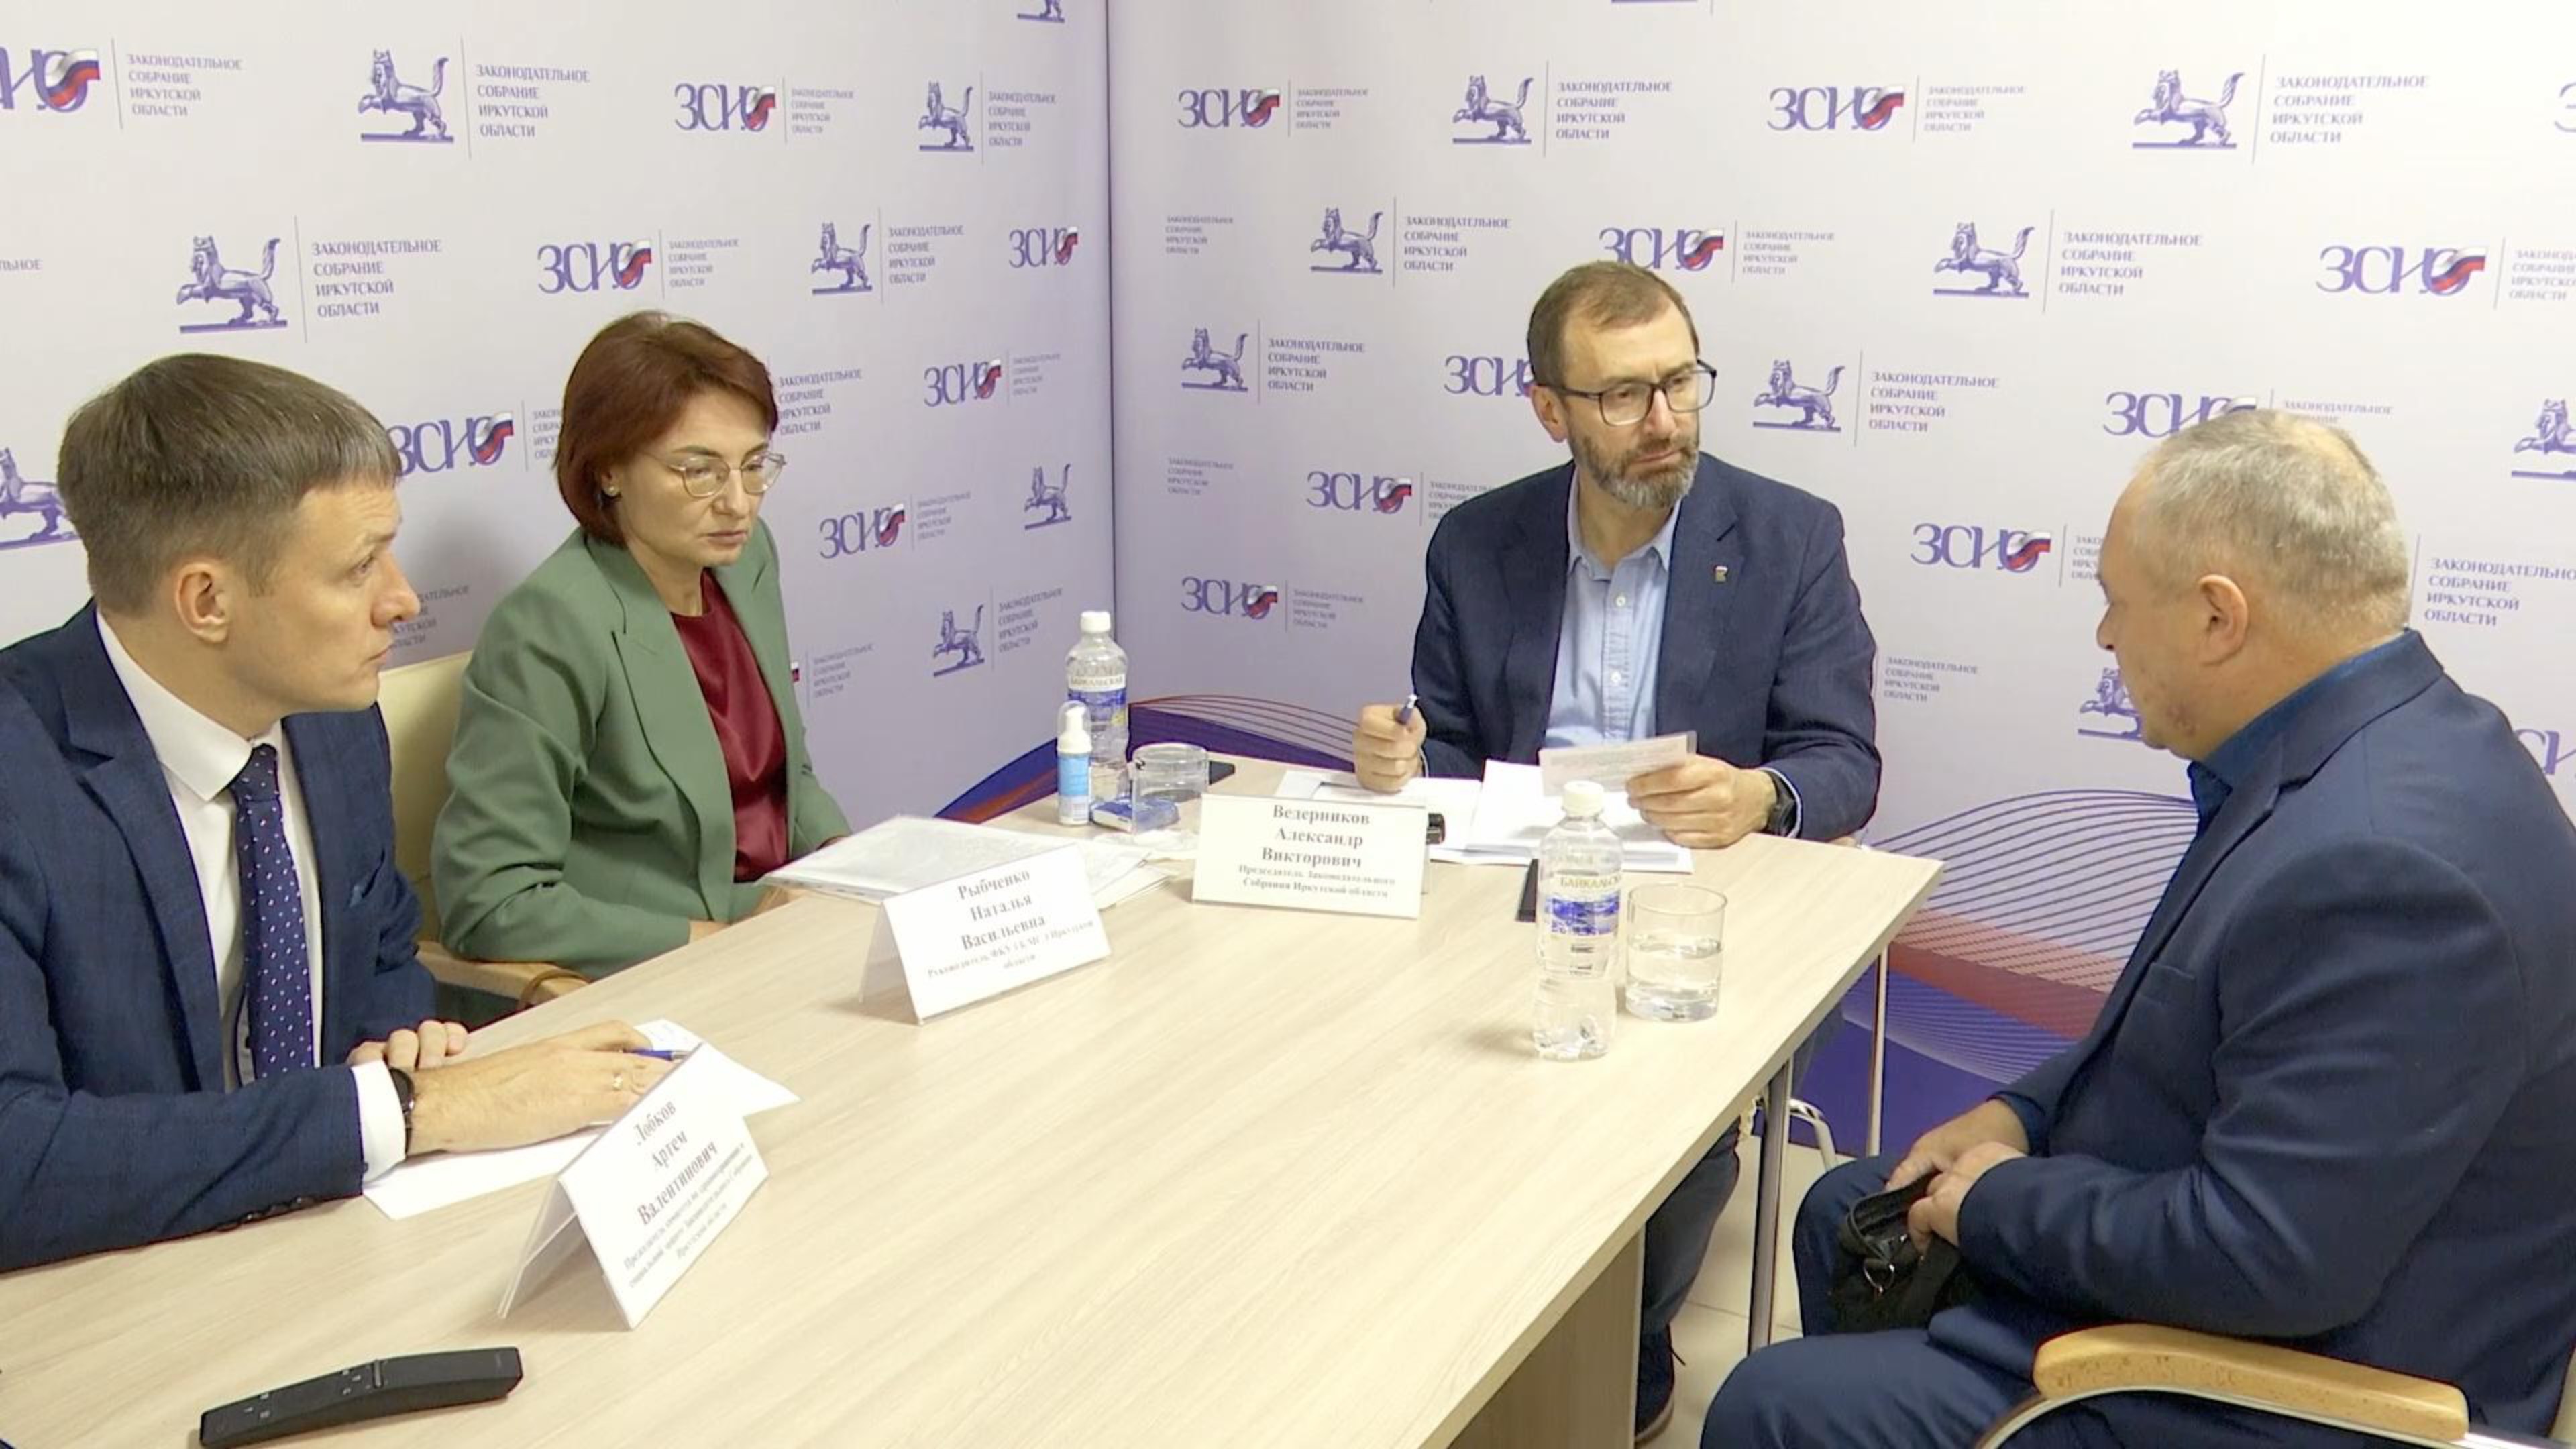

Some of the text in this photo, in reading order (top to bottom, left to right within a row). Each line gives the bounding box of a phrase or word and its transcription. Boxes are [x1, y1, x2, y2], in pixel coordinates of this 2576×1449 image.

[476, 64, 591, 83] ЗАКОНОДАТЕЛЬНОЕ
[1558, 80, 1672, 94] ЗАКОНОДАТЕЛЬНОЕ
[2277, 74, 2426, 90] ЗАКОНОДАТЕЛЬНОЕ
[476, 84, 539, 99] СОБРАНИЕ
[1556, 97, 1618, 109] СОБРАНИЕ
[2273, 95, 2351, 107] СОБРАНИЕ
[478, 103, 549, 119] ИРКУТСКОЙ
[1556, 112, 1626, 124] ИРКУТСКОЙ
[2272, 112, 2363, 125] ИРКУТСКОЙ
[479, 123, 535, 138] ОБЛАСТИ
[1555, 128, 1610, 140] ОБЛАСТИ
[2269, 131, 2341, 144] ОБЛАСТИ
[1407, 215, 1510, 229] ЗАКОНОДАТЕЛЬНОЕ
[1403, 231, 1458, 243] СОБРАНИЕ
[2064, 231, 2202, 246] ЗАКОНОДАТЕЛЬНОЕ
[311, 239, 442, 256] ЗАКОНОДАТЕЛЬНОЕ
[1403, 246, 1468, 258] ИРКУТСКОЙ
[2061, 249, 2133, 262] СОБРАНИЕ
[313, 260, 384, 277] СОБРАНИЕ
[1403, 260, 1454, 272] ОБЛАСТИ
[2060, 266, 2144, 280] ИРКУТСКОЙ
[315, 278, 394, 297] ИРКУТСКОЙ
[2058, 282, 2125, 296] ОБЛАСТИ
[317, 301, 380, 318] ОБЛАСТИ
[1269, 337, 1365, 353] ЗАКОНОДАТЕЛЬНОЕ
[1267, 352, 1320, 365] СОБРАНИЕ
[1267, 366, 1328, 379] ИРКУТСКОЙ
[1873, 371, 1998, 388] ЗАКОНОДАТЕЛЬНОЕ
[1267, 380, 1314, 392] ОБЛАСТИ
[1870, 386, 1935, 401] СОБРАНИЕ
[1870, 402, 1946, 418] ИРКУТСКОЙ
[1868, 419, 1929, 433] ОБЛАСТИ
[2431, 557, 2576, 580] ЗАКОНОДАТЕЛЬНО
[2428, 575, 2508, 592] СОБРАНИЕ
[2426, 592, 2520, 611] ИРКУТСКОЙ
[2424, 608, 2498, 627] ОБЛАСТИ
[1273, 804, 1371, 826] Ведерников
[1275, 828, 1364, 848] Александр
[1261, 847, 1362, 869] Викторович
[957, 871, 1031, 900] Рыбченко
[971, 894, 1033, 922] Наталья
[961, 916, 1046, 951] Васильевна
[651, 1130, 688, 1169] Артем
[637, 1141, 718, 1225] Валентинович
